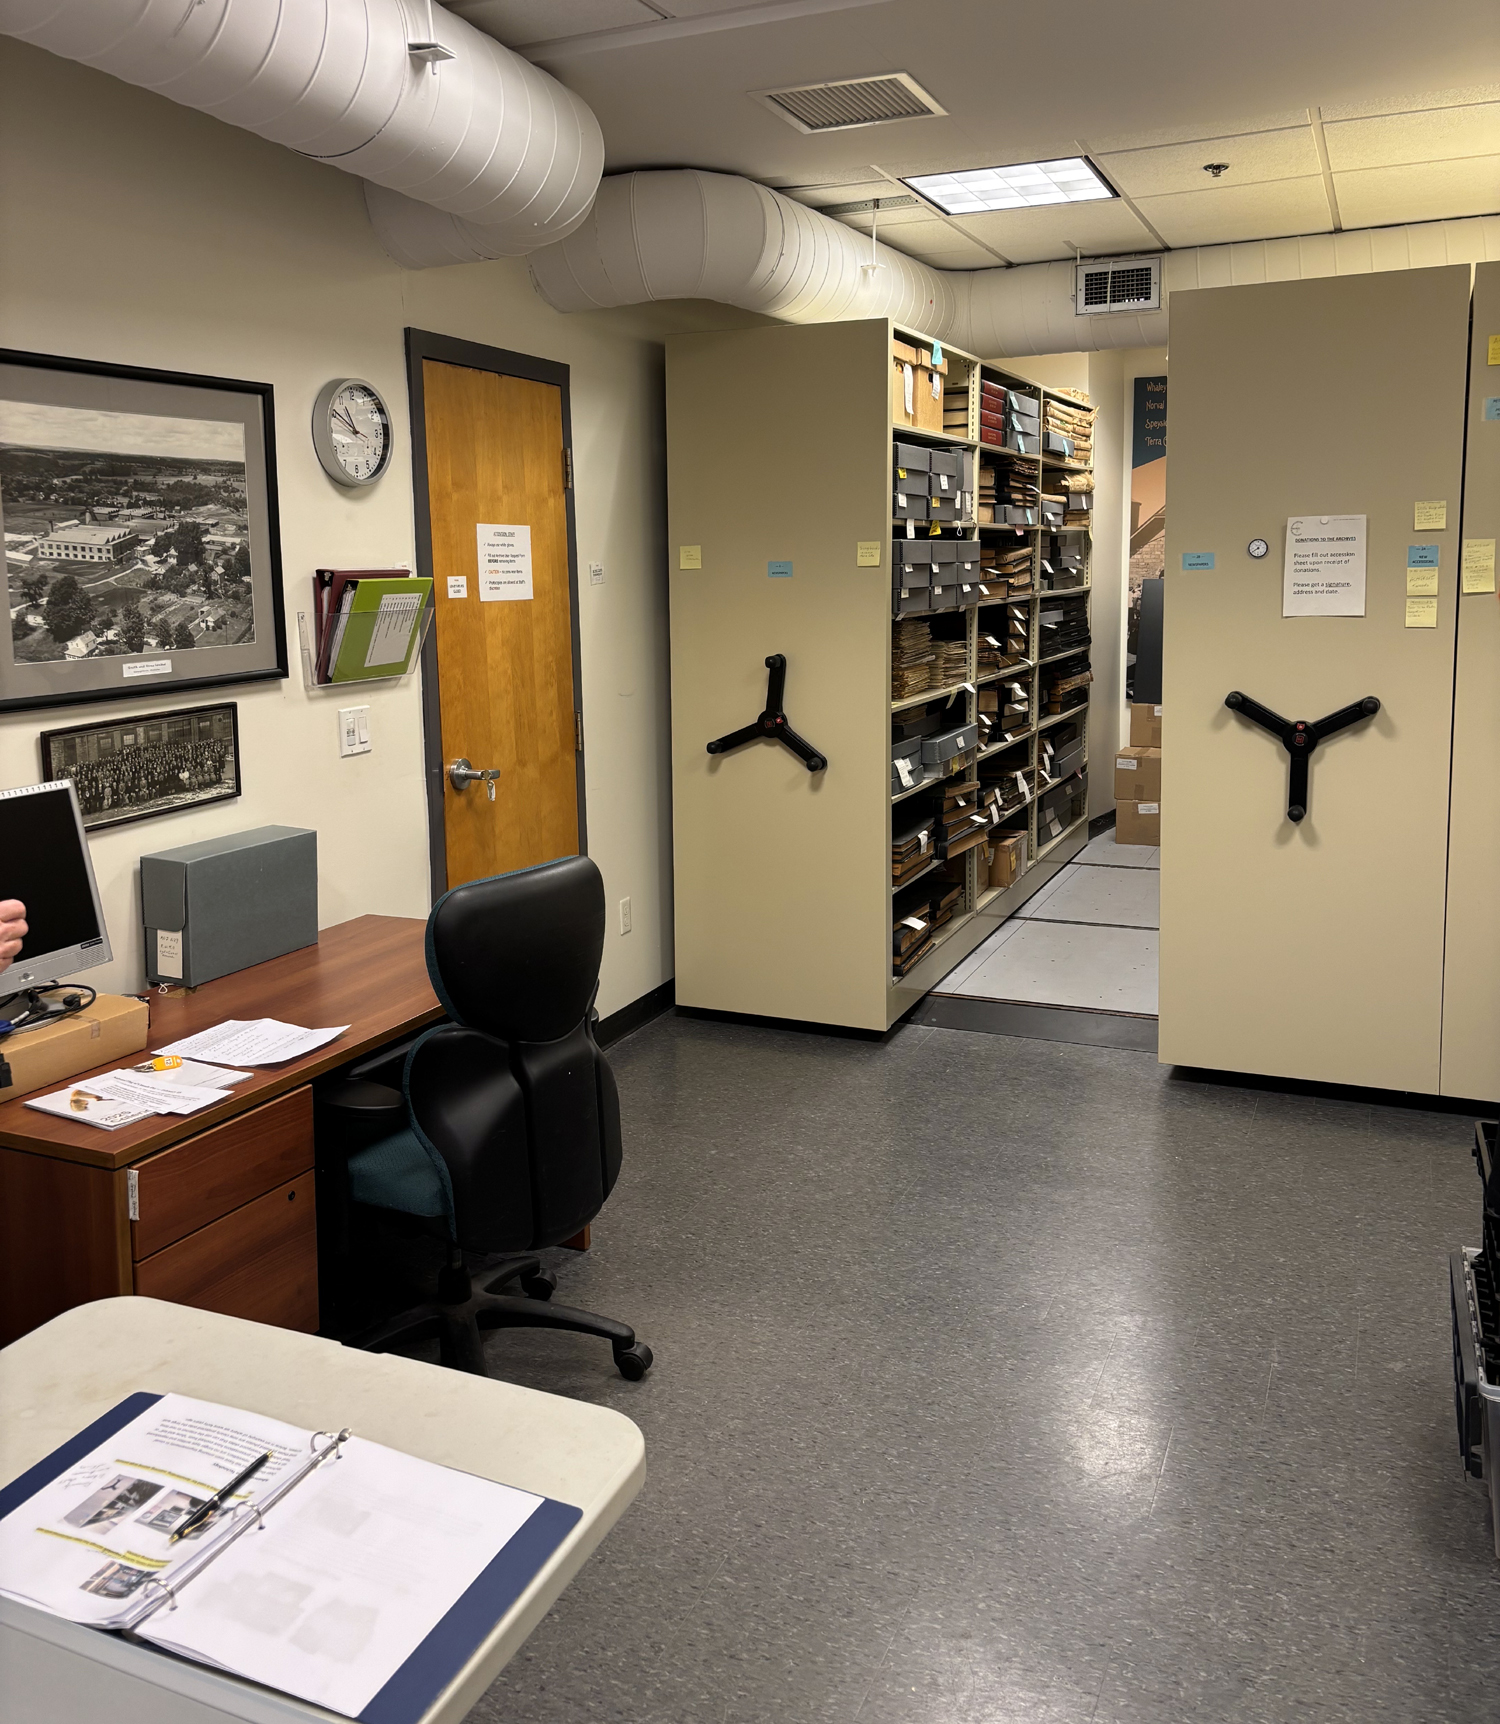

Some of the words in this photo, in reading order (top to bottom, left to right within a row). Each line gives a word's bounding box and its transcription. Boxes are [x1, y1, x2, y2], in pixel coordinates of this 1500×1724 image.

[349, 391, 354, 400] 12
[339, 396, 344, 405] 11
[362, 397, 365, 406] 1
[1146, 400, 1164, 411] Norval
[370, 411, 374, 420] 2
[375, 429, 378, 438] 3
[1145, 436, 1161, 446] Terra
[373, 447, 377, 456] 4
[343, 459, 347, 469] 7
[366, 460, 370, 470] 5
[355, 464, 359, 474] 6
